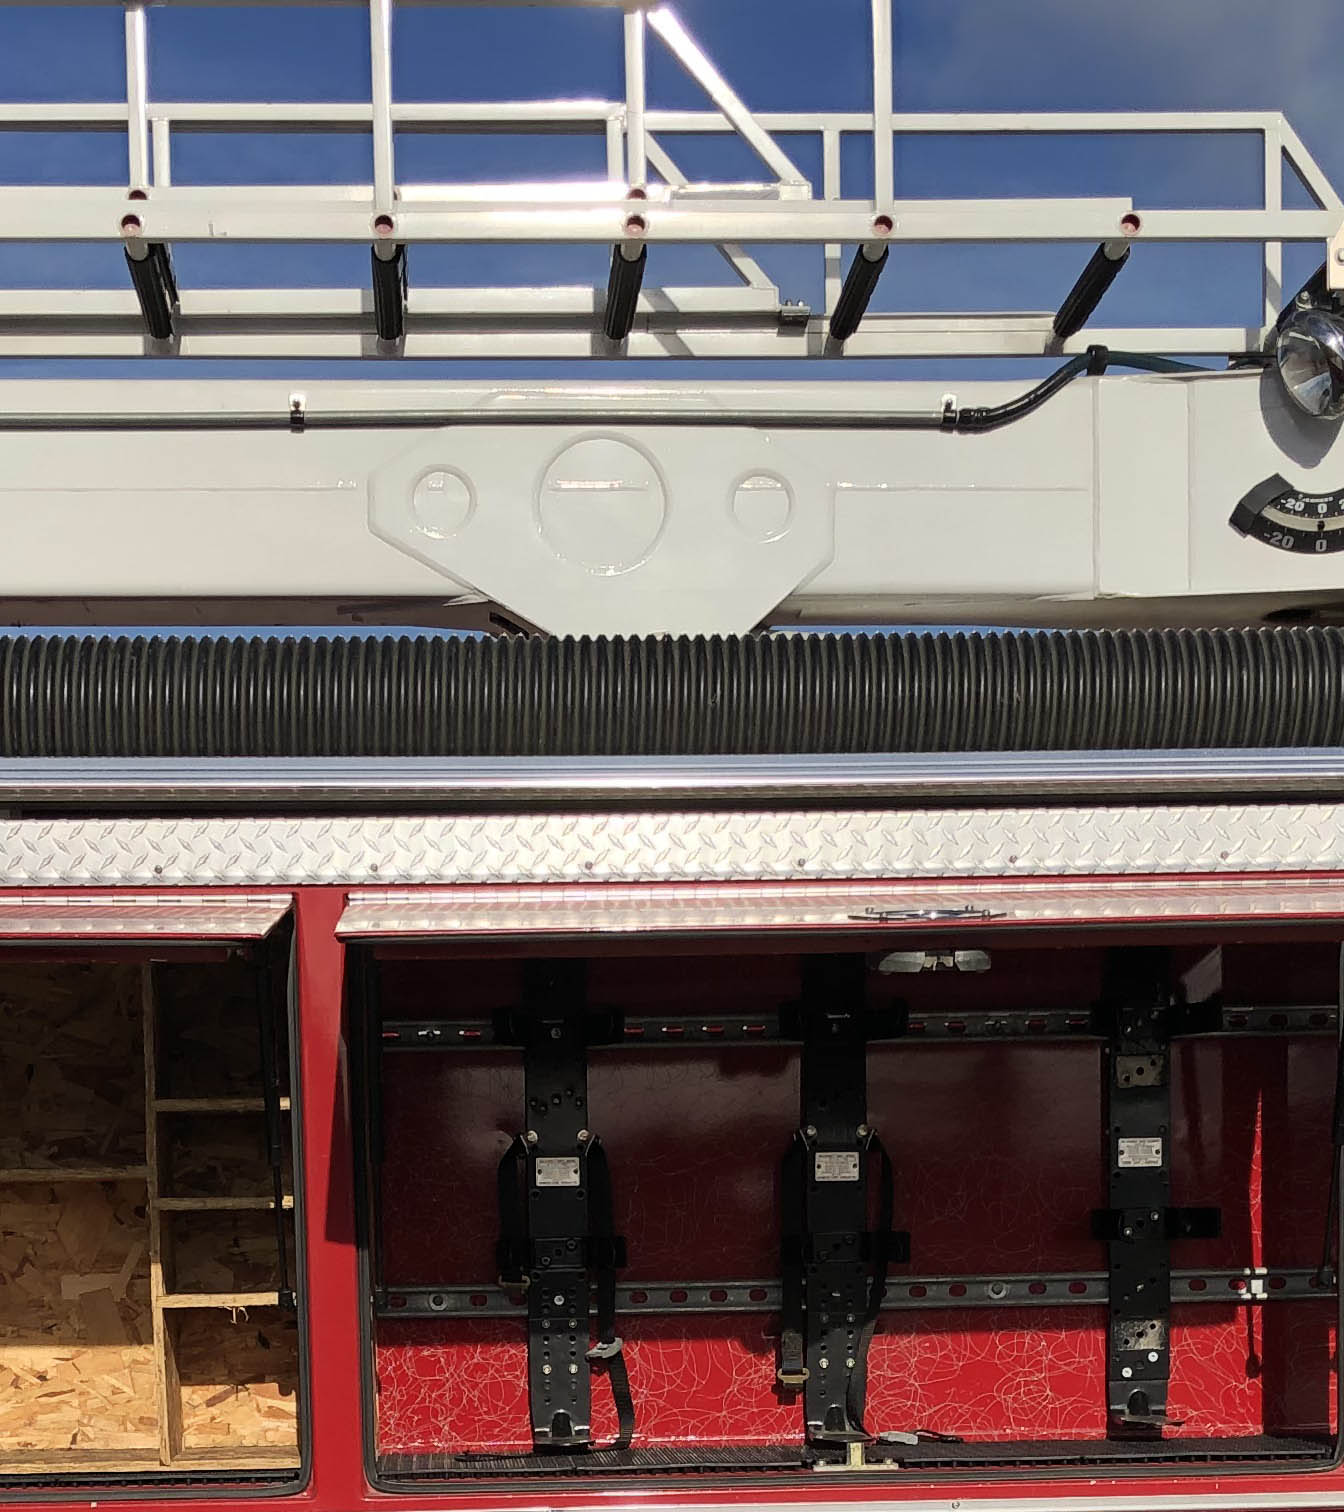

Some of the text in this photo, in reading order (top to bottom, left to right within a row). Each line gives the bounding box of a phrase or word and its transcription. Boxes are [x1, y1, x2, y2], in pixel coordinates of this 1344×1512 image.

[1281, 498, 1304, 511] -20
[1317, 503, 1327, 513] 0
[1263, 532, 1294, 549] -20
[1316, 539, 1327, 552] 0
